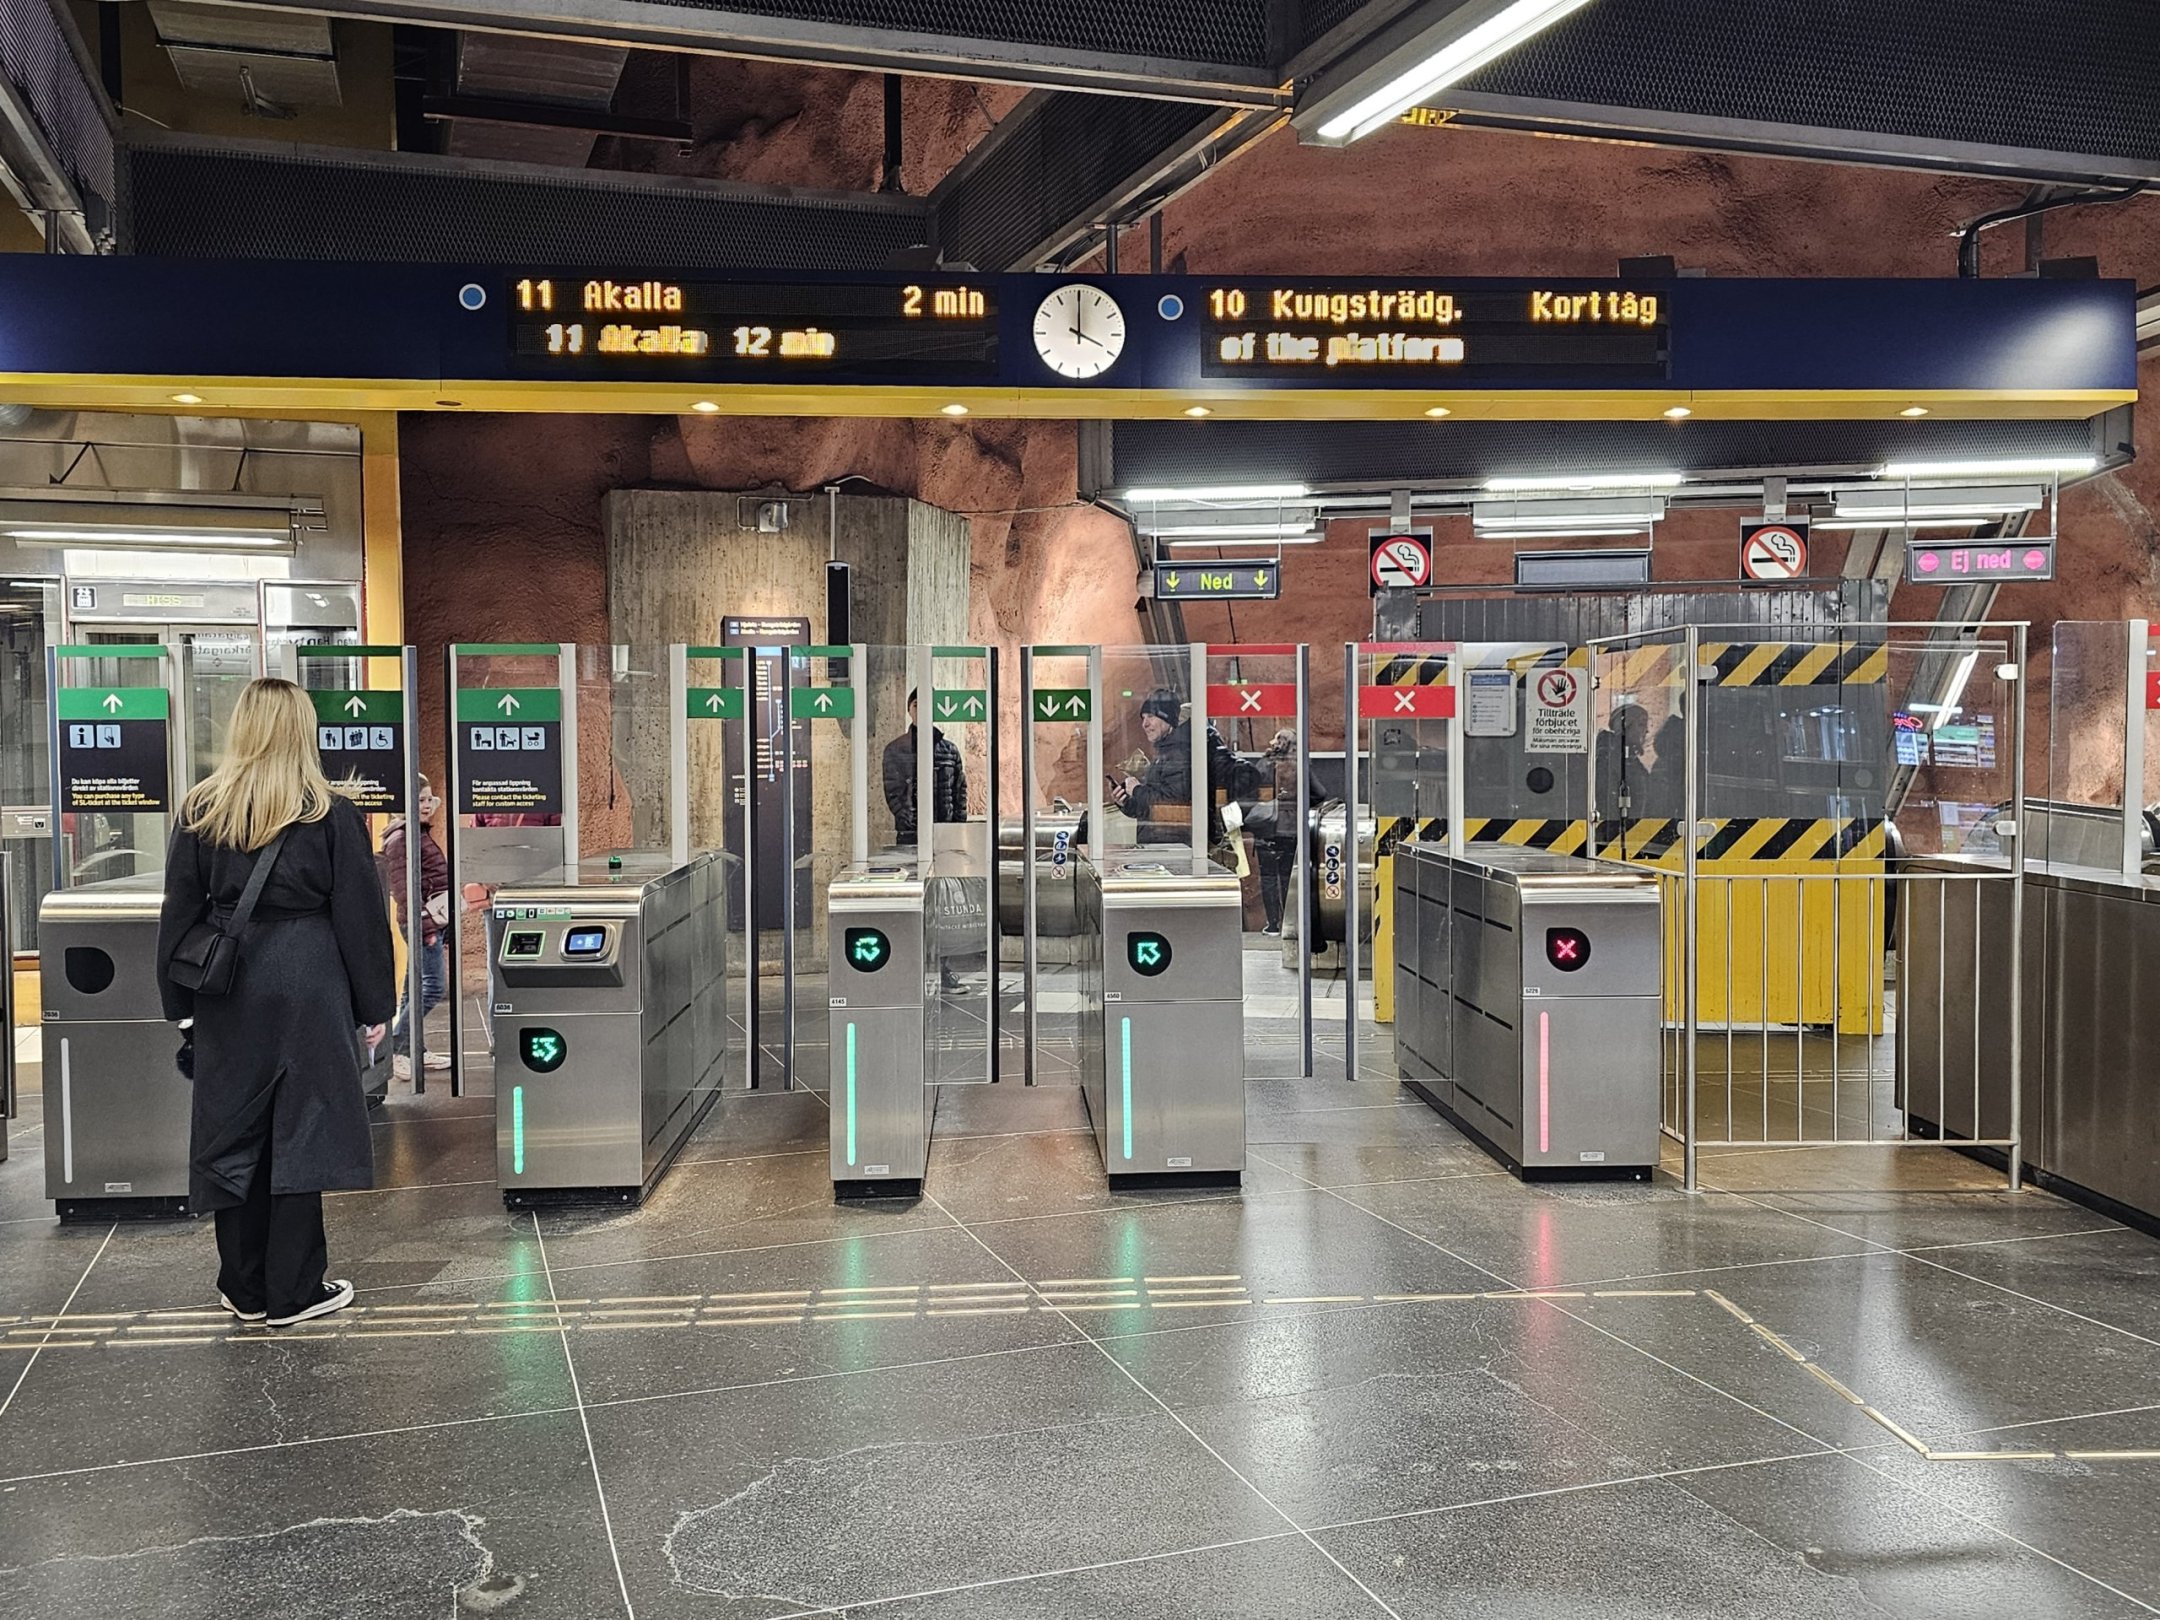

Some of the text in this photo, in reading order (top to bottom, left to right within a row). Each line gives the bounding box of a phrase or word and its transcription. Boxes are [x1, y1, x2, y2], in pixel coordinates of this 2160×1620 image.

[516, 279, 682, 311] 11 Akalla
[903, 285, 984, 316] 2 min
[1210, 289, 1462, 324] 10 Kungsträdg.
[546, 323, 583, 354] 11
[598, 324, 708, 354] Akalla
[733, 326, 772, 356] 12
[1951, 549, 2012, 574] Ej ned
[1200, 572, 1233, 590] Ned
[1538, 708, 1576, 718] Tillträde
[944, 903, 982, 916] STUNDA
